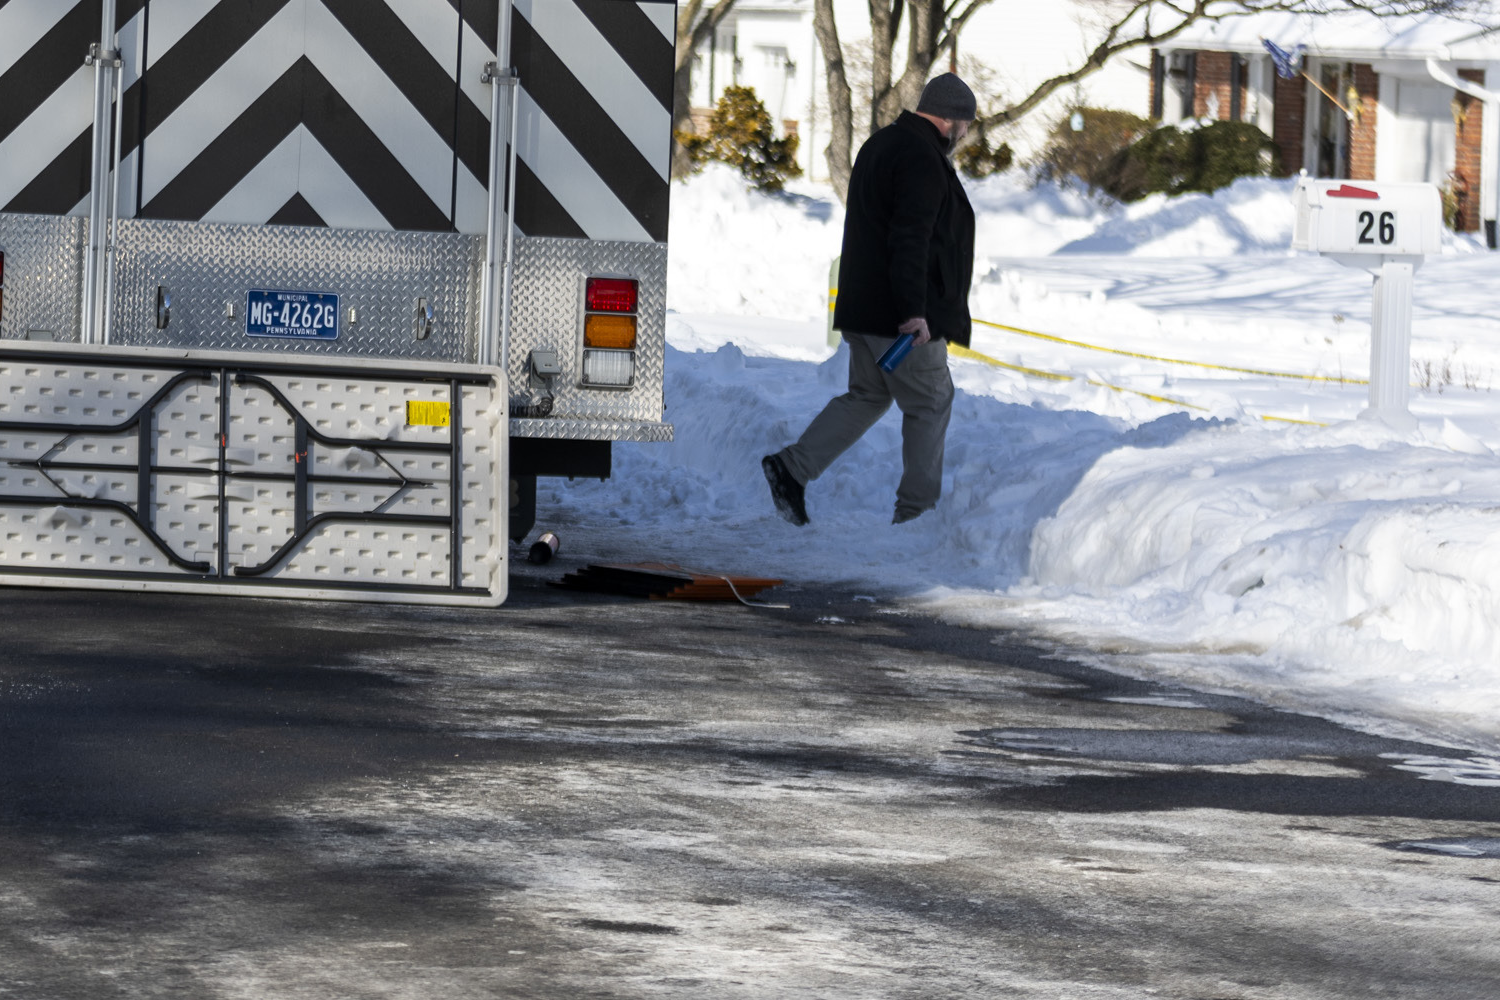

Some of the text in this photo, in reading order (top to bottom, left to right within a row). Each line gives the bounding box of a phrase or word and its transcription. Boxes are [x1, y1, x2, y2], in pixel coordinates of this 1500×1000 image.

[1358, 210, 1395, 245] 26
[277, 294, 309, 302] MUNICIPAL
[250, 301, 334, 329] MG-4262G
[266, 326, 317, 335] PENNSYLVANIA
